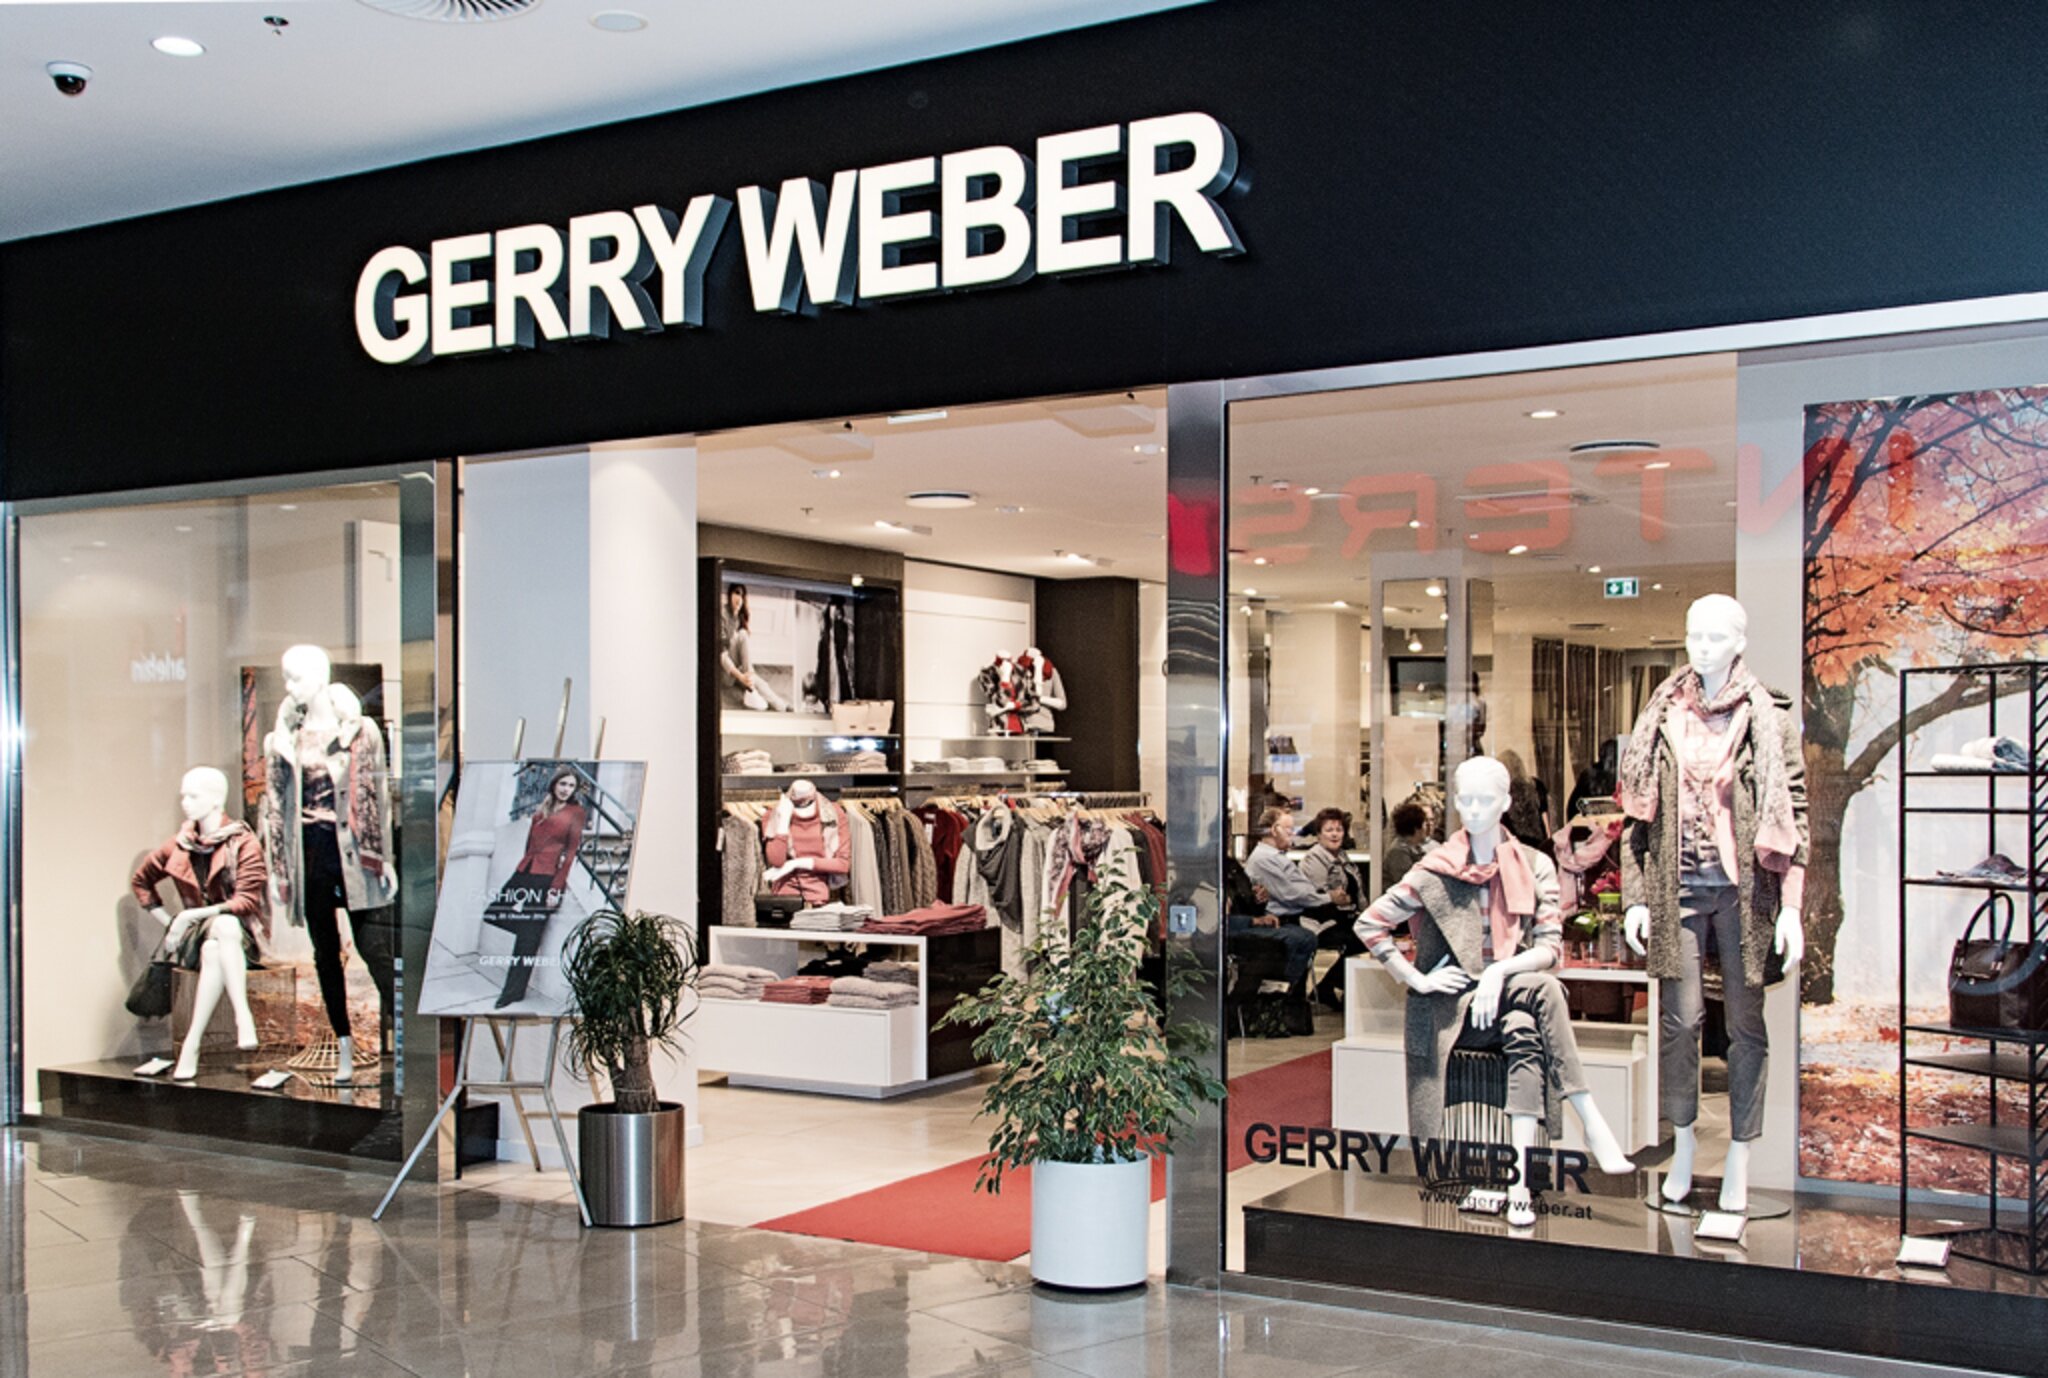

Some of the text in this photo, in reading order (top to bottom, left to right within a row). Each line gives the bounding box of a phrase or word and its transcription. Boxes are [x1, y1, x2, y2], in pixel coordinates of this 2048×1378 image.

[353, 110, 1246, 366] GERRY WEBER
[467, 887, 543, 905] FASHION
[479, 954, 560, 968] GERRY WEBE
[1244, 1121, 1592, 1194] GERRY WEBER
